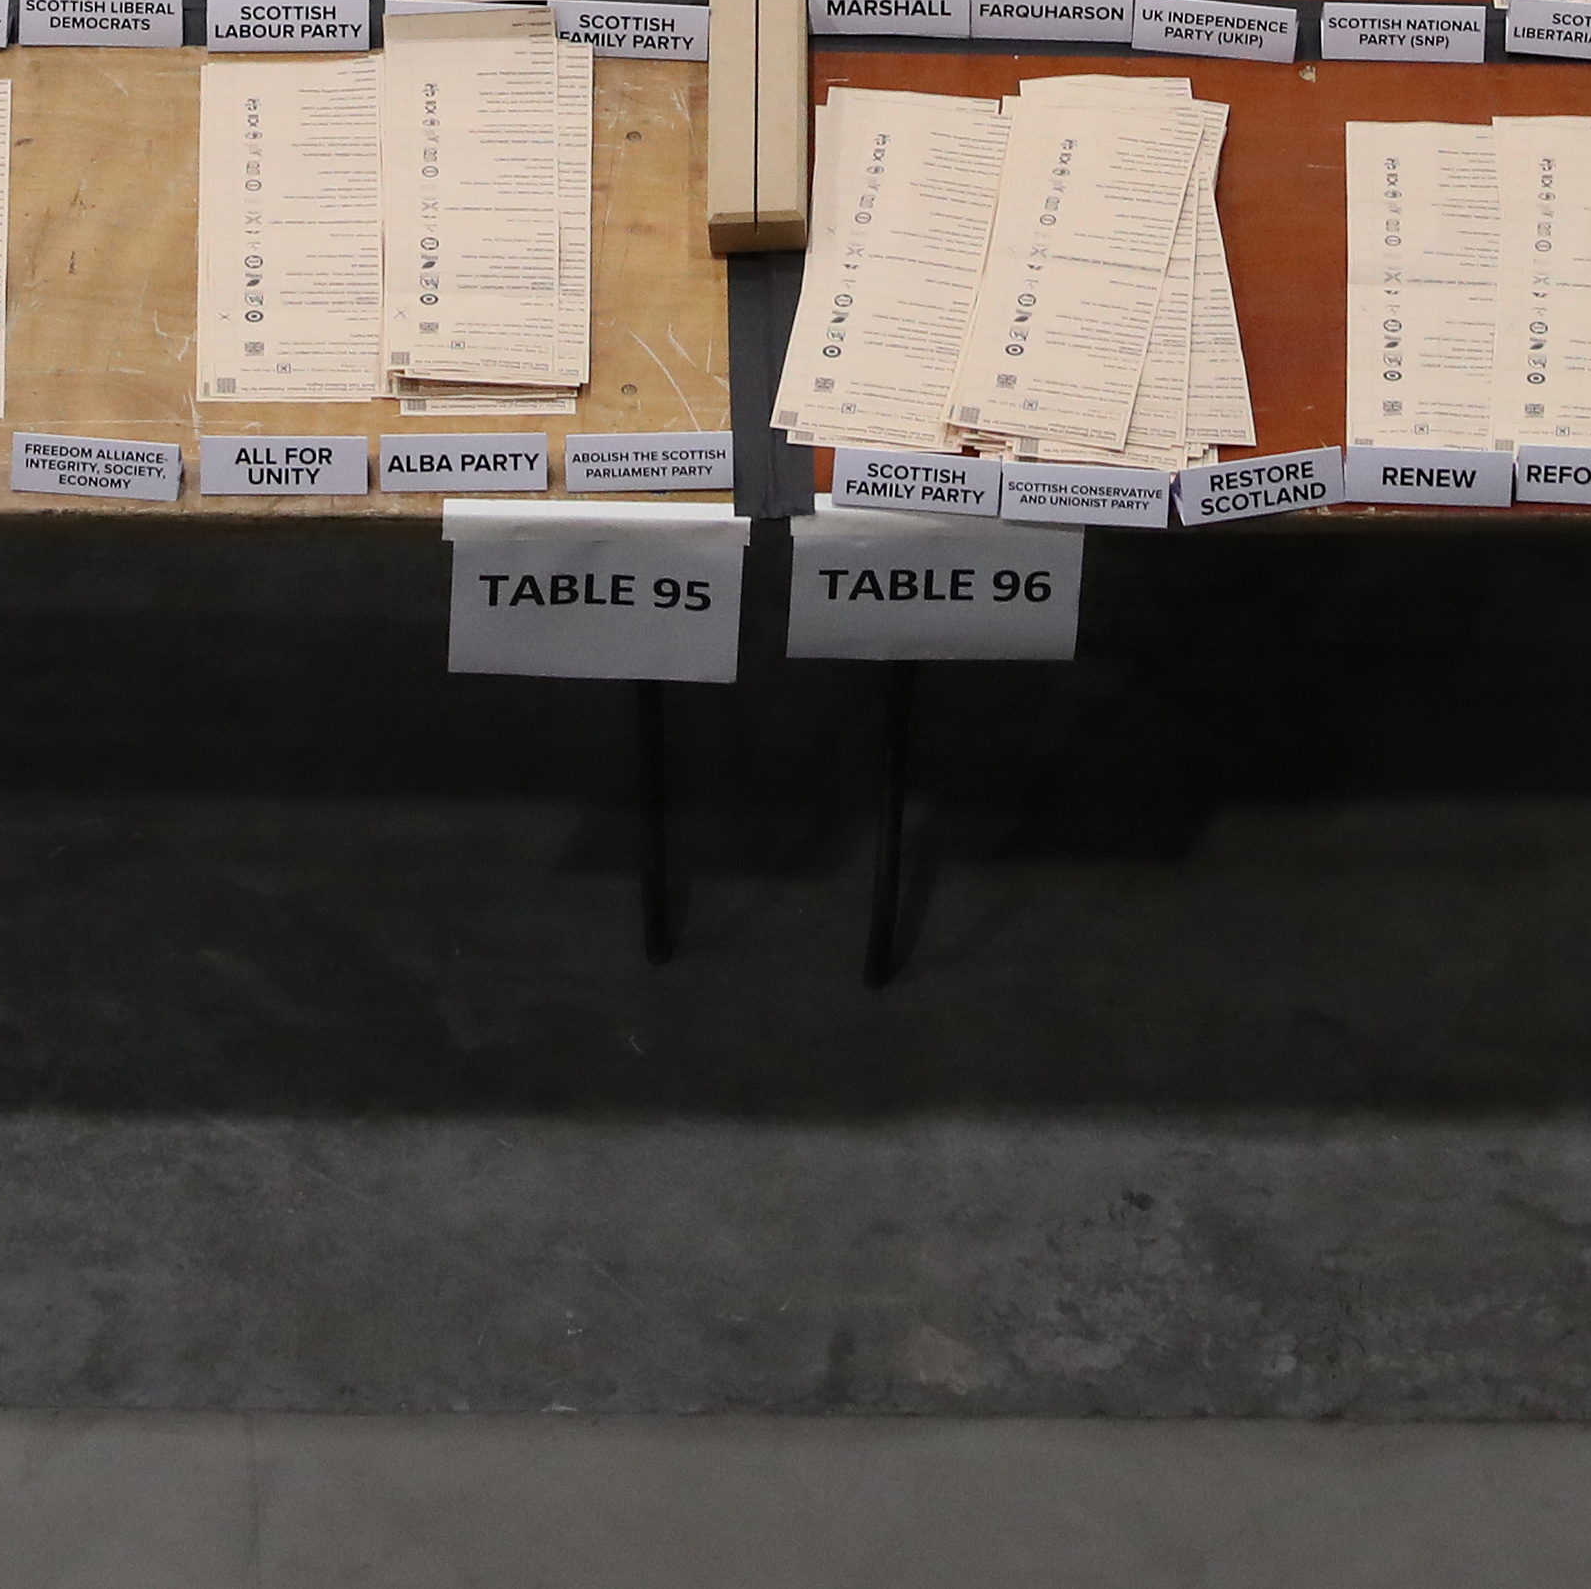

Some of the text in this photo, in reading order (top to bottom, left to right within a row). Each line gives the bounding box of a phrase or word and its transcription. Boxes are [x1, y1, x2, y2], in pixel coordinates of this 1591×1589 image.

[26, 0, 175, 15] SCOTTISH LIBERAL
[240, 5, 336, 20] SCOTTISH
[826, 0, 952, 16] MARSHALL
[979, 4, 1124, 21] FARQUHARSON
[50, 17, 151, 31] DEMOCRATS
[579, 14, 675, 32] SCOTTISH
[1142, 9, 1288, 33] UK INDEPENDENCE
[1328, 17, 1481, 32] SCOTTISH NATIONAL
[215, 23, 362, 38] LABOUR PARTY
[1164, 27, 1264, 48] PARTY (UKIP)
[633, 35, 694, 50] PARTY
[1359, 34, 1449, 48] PARTY (SNP)
[25, 443, 92, 459] FREEDOM
[235, 448, 332, 465] ALL FOR
[572, 449, 726, 463] ABOLISH THE SCOTTISH
[25, 458, 167, 479] INTEGRITY, SOCIETY,
[388, 453, 539, 473] ALBA PARTY
[248, 468, 320, 485] UNITY
[586, 466, 713, 478] PARLIAMENT PARTY
[867, 463, 966, 485] SCOTTISH
[1210, 461, 1314, 492] RESTORE
[1382, 466, 1476, 488] RENEW
[59, 474, 131, 489] ECONOMY
[846, 480, 986, 505] FAMILY PARTY
[1008, 481, 1163, 500] SCOTTISH CONSERVATIVE
[1201, 481, 1326, 516] SCOTLAND
[1020, 494, 1150, 511] AND UNIONIST PARTY
[479, 573, 712, 611] TABLE 95
[819, 569, 1053, 602] TABLE 96
